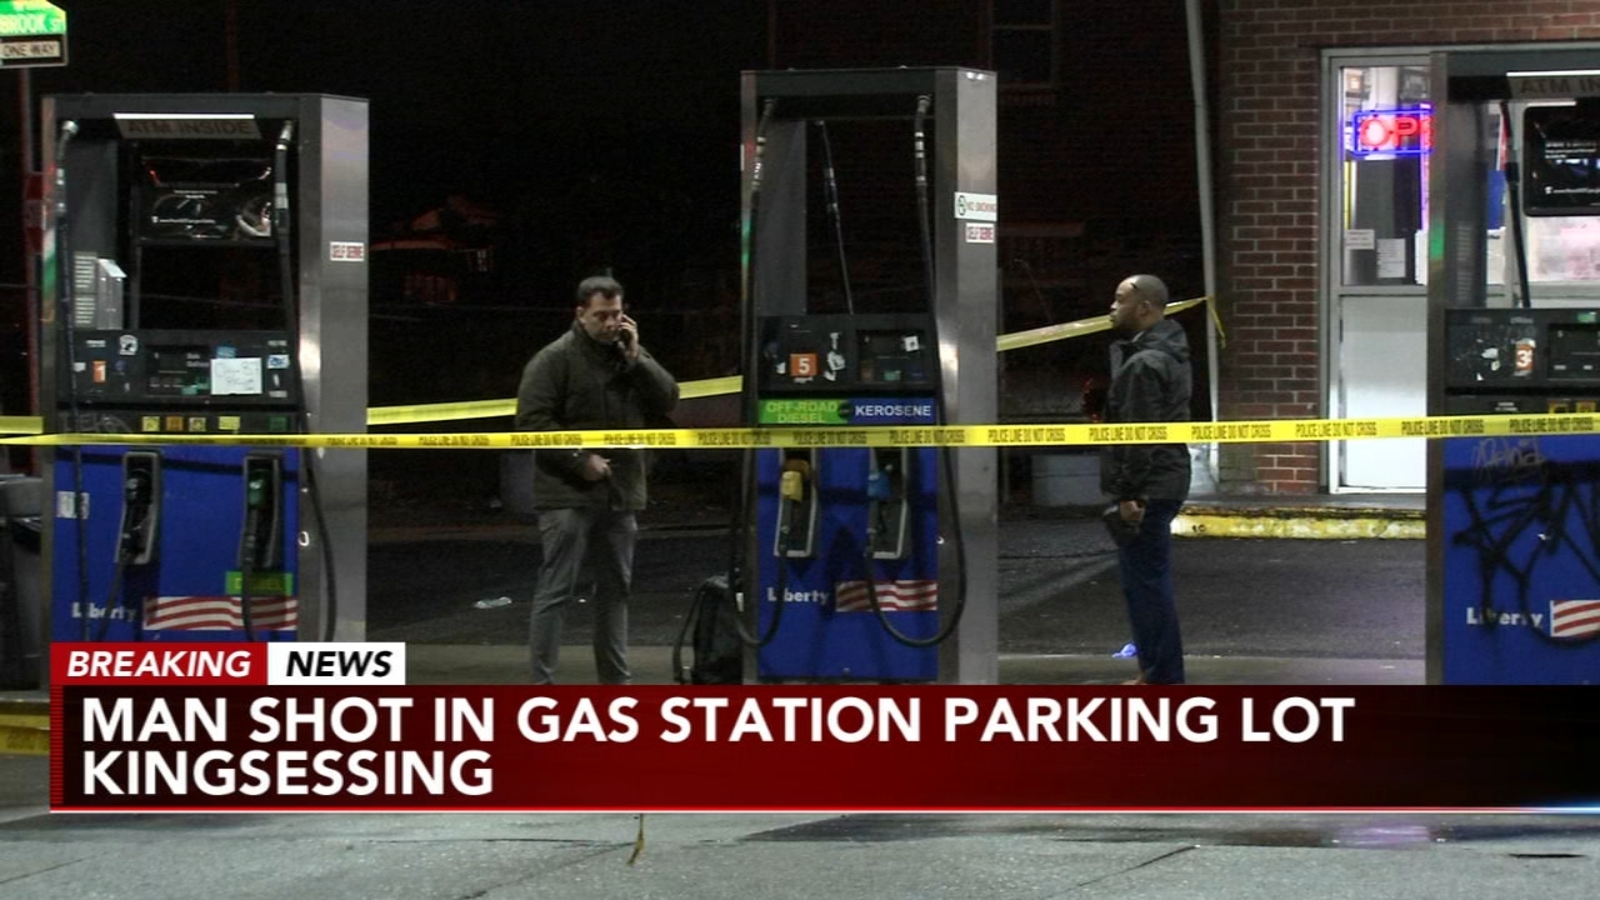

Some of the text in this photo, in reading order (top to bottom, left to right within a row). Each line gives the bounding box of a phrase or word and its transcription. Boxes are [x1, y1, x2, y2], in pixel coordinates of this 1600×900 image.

[4, 44, 27, 57] ONE
[1521, 79, 1571, 93] ATM
[128, 119, 254, 134] ATM INSIDE
[798, 357, 811, 374] 5
[1516, 350, 1532, 367] 3
[766, 400, 838, 412] OFF-ROAD
[855, 404, 932, 417] KEROSENE
[777, 413, 827, 424] DIESEL
[767, 587, 830, 606] Lberty
[72, 601, 136, 622] Lbrty
